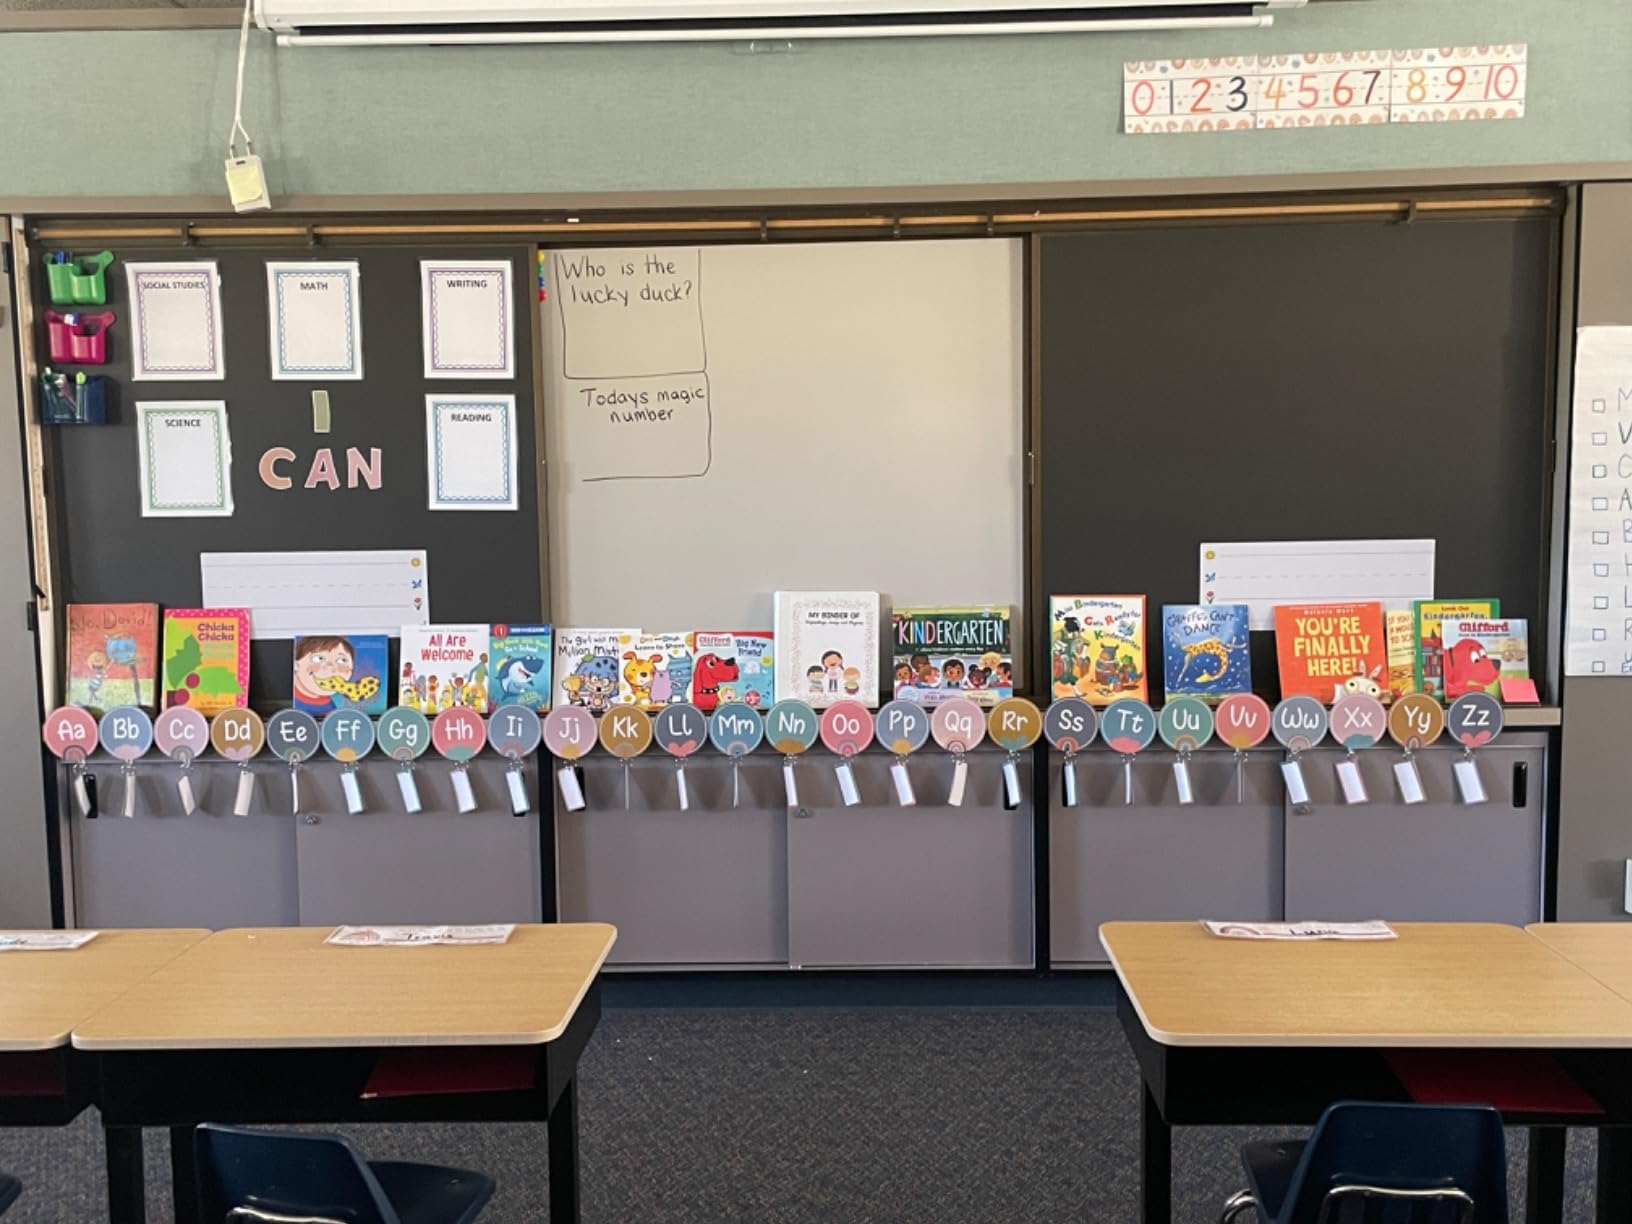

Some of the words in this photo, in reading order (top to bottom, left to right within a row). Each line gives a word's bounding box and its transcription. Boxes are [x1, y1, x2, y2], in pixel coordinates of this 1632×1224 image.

[1131, 80, 1155, 115] 0
[1189, 78, 1213, 113] 2
[1225, 76, 1248, 112] 3
[1264, 76, 1286, 110] 4
[1298, 73, 1319, 109] 5
[1332, 71, 1354, 107] 6
[1363, 70, 1381, 105] 7
[1407, 68, 1427, 103] 8
[1444, 66, 1466, 101] 9
[1483, 63, 1518, 100] 10
[560, 254, 605, 279] Who
[621, 264, 635, 275] is
[646, 254, 676, 275] the
[143, 281, 170, 289] SOCIAL
[172, 281, 205, 289] STUDIES
[300, 281, 328, 291] MATH
[446, 279, 487, 289] WRITING
[571, 285, 629, 307] lucky
[640, 279, 692, 302] duck?
[580, 387, 649, 407] Todays
[657, 386, 705, 404] magic
[165, 418, 201, 428] SCIENCE
[312, 390, 331, 433] I
[451, 413, 492, 423] READING
[610, 408, 674, 424] number
[258, 446, 382, 490] CAN
[850, 611, 860, 619] OF
[1295, 616, 1361, 636] YOU'RE
[1458, 621, 1509, 632] Clifford
[197, 622, 234, 632] Chicka
[197, 631, 234, 641] Chicka
[899, 619, 1004, 646] KINDERGARTEN
[1183, 623, 1221, 636] DANCE
[429, 633, 443, 647] All
[445, 634, 466, 647] Are
[1294, 634, 1370, 657] FINALLY
[421, 648, 474, 662] Welcome
[1307, 656, 1357, 677] HERE!
[506, 715, 523, 738] Ii
[613, 715, 639, 738] Kk
[668, 714, 693, 737] Ll
[718, 714, 755, 736] Mm
[778, 711, 806, 735] Nn
[832, 713, 860, 735] Oo
[888, 710, 916, 737] Pp
[944, 711, 973, 739] Qq
[1002, 710, 1028, 732] Rr
[1058, 709, 1084, 732] Ss
[1117, 708, 1144, 734] Tt
[1172, 708, 1200, 730] Uu
[1230, 704, 1257, 727] Vv
[1281, 706, 1320, 729] Ww
[1344, 706, 1372, 729] Xx
[1404, 705, 1432, 734] Yy
[1461, 704, 1490, 727] Zz
[57, 718, 86, 741] Aa
[113, 717, 140, 739] Bb
[169, 718, 195, 740] Cc
[224, 718, 250, 741] Dd
[280, 720, 308, 742] Ee
[335, 719, 362, 741] Ff
[389, 719, 417, 746] Gg
[445, 718, 473, 741] Hh
[559, 717, 581, 744] Jj
